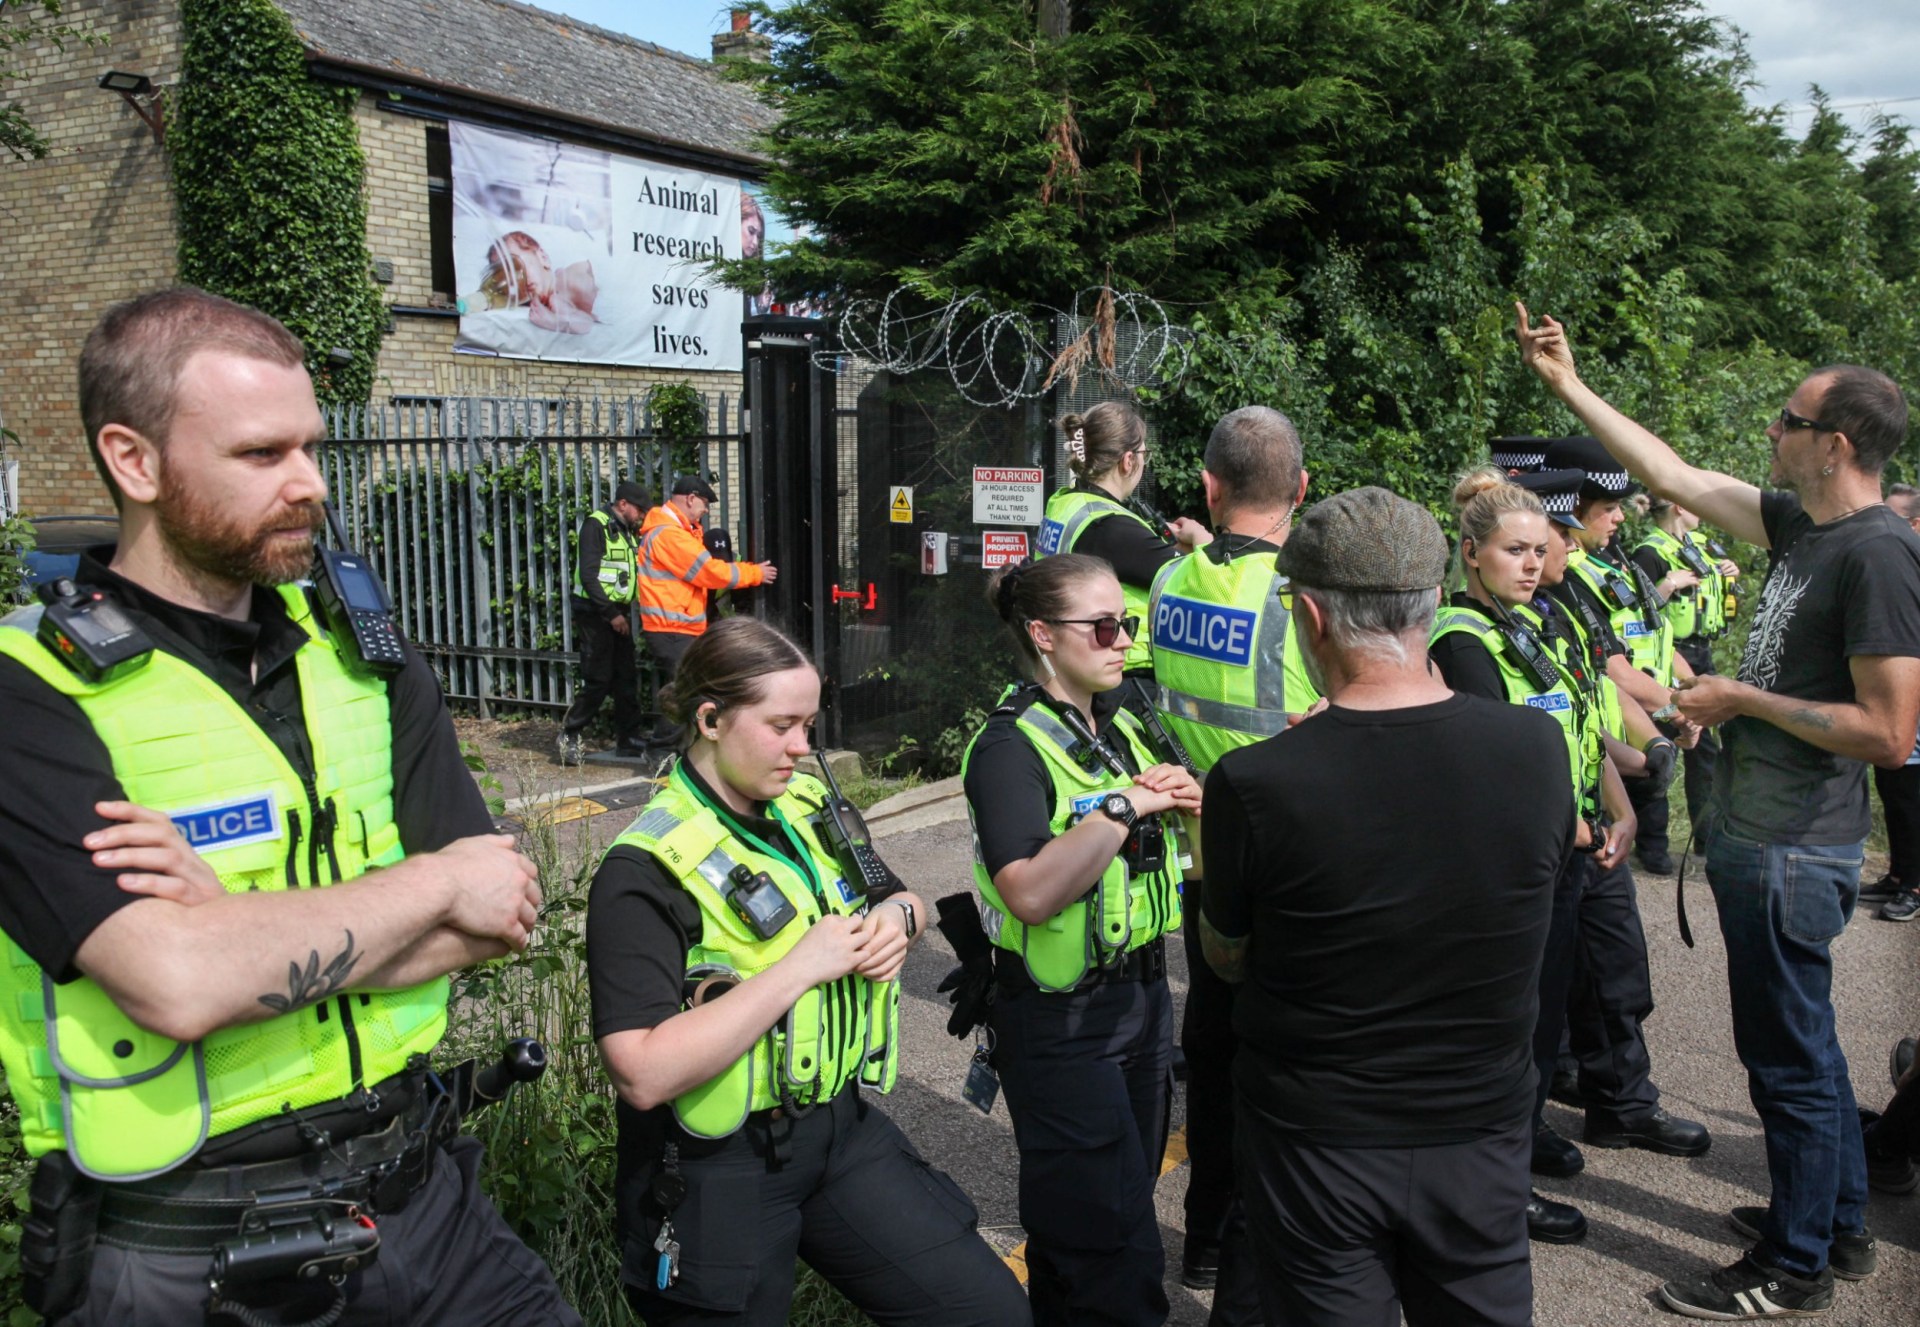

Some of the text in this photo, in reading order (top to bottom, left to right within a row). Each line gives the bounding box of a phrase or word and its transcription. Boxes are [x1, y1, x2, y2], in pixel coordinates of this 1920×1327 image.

[638, 175, 719, 216] Animal
[632, 231, 724, 263] research
[652, 283, 708, 309] saves
[653, 325, 708, 356] lives.
[977, 471, 1039, 482] NO PARKING
[992, 494, 1024, 502] REQUIRED
[986, 543, 1025, 552] PROPERTY
[986, 554, 1007, 564] KEEP
[1156, 603, 1248, 655] POLICE
[1530, 695, 1568, 710] POLICE
[174, 806, 266, 842] LICE
[664, 845, 683, 864] 716
